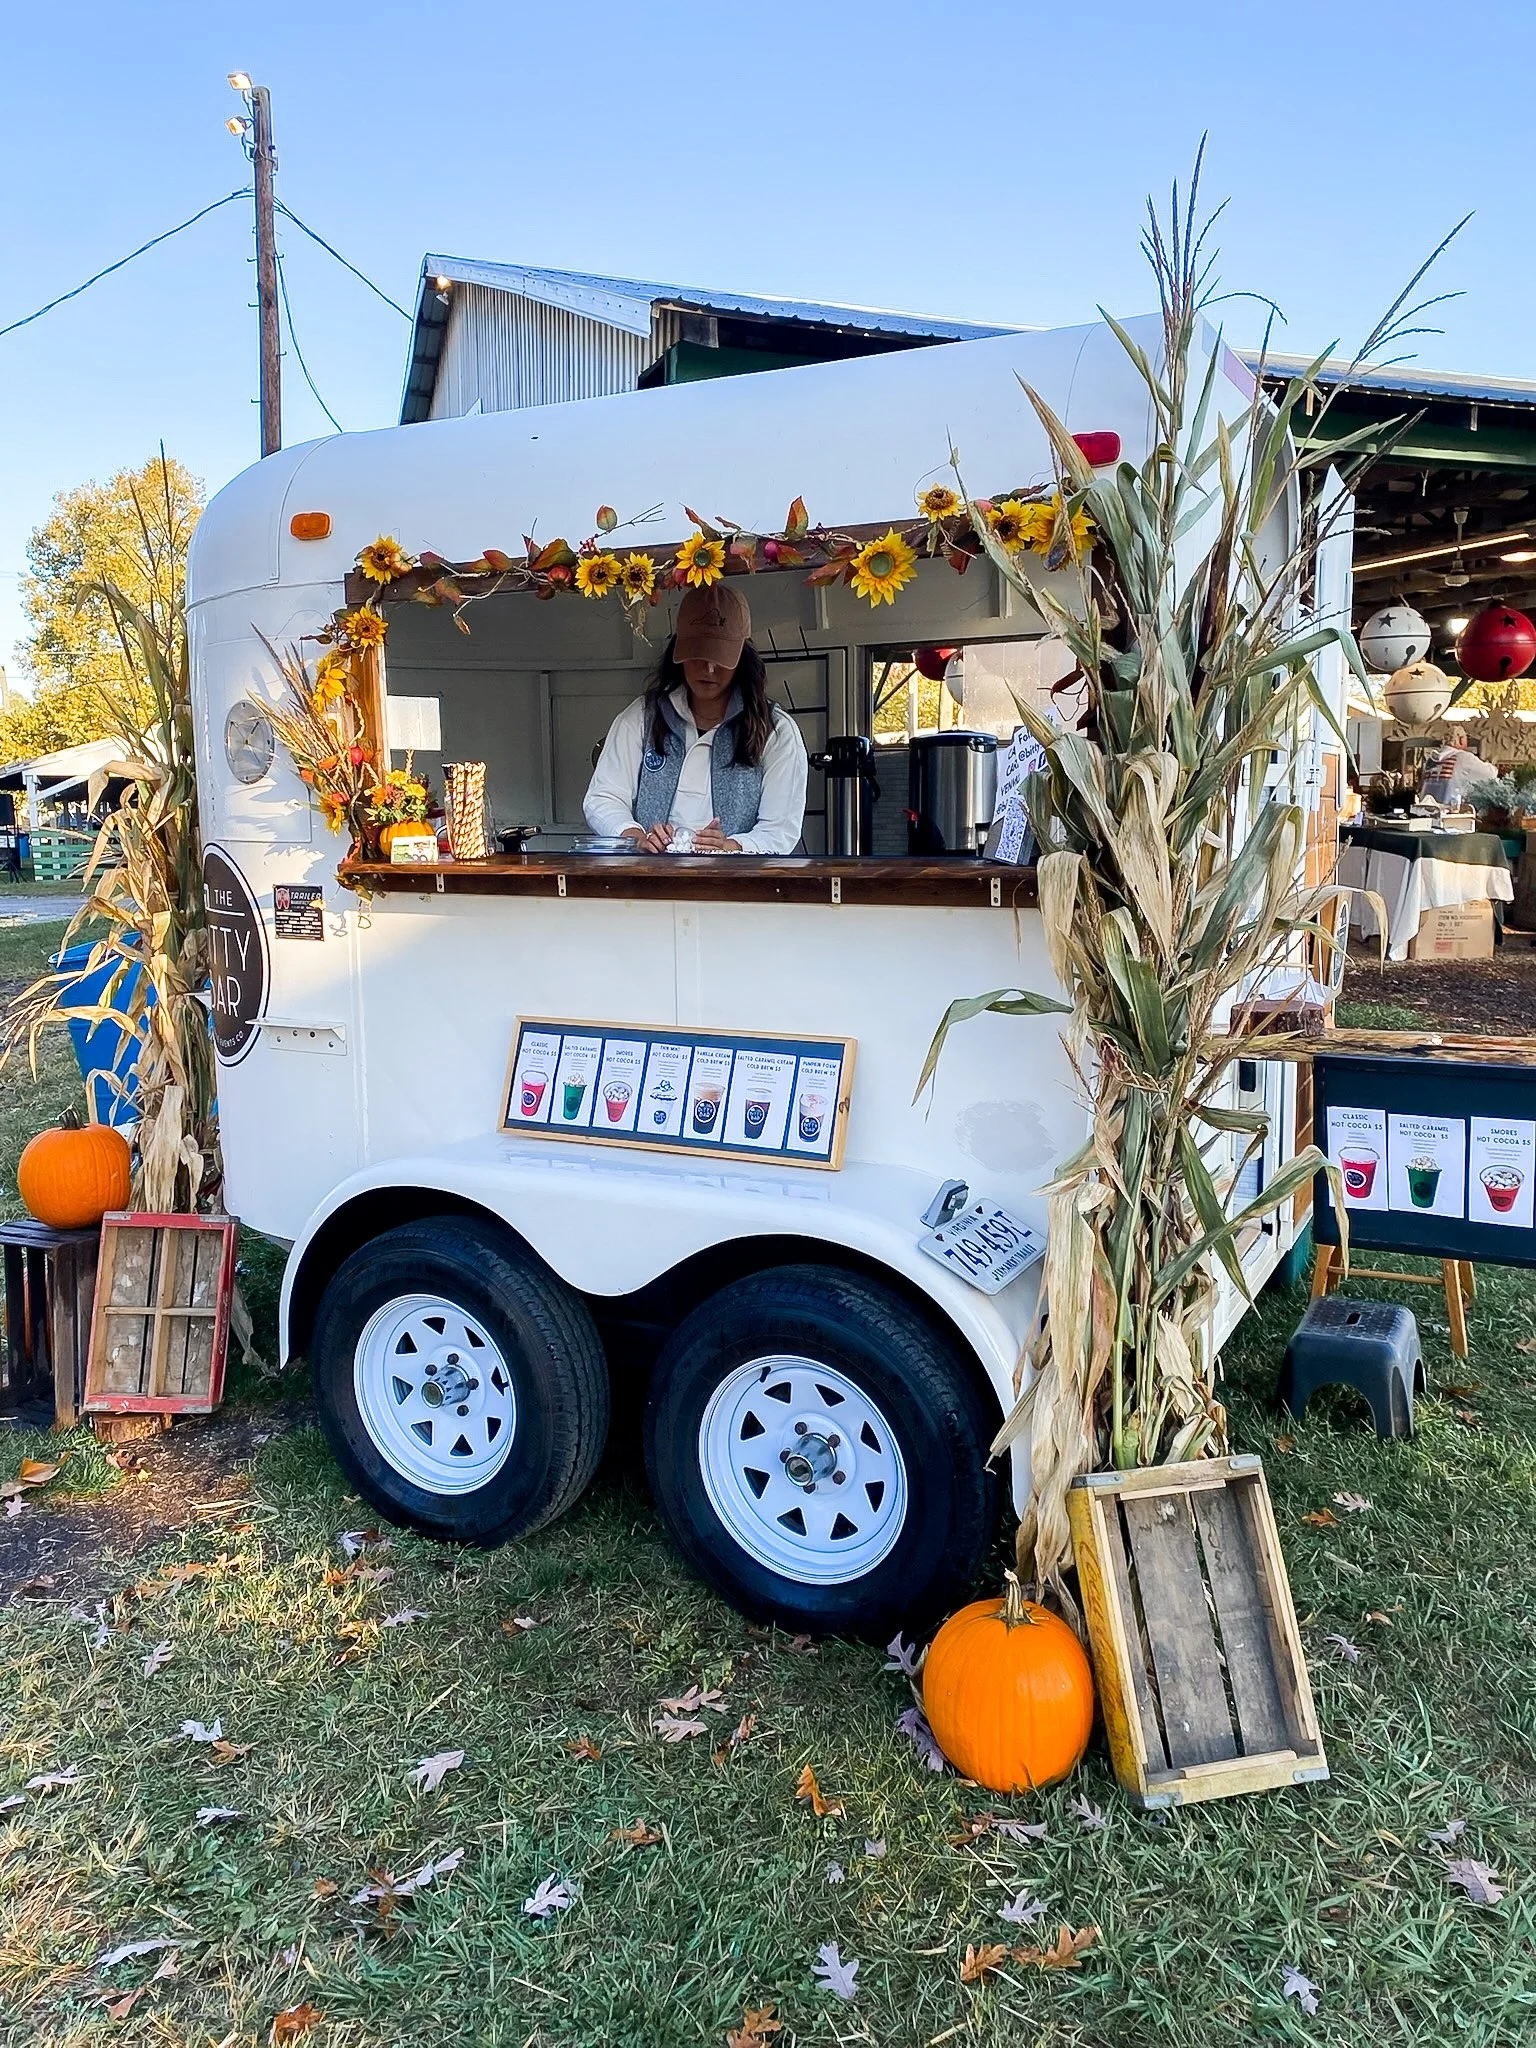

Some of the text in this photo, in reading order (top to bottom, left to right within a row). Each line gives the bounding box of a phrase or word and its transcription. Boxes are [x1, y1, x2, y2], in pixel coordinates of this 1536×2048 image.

[214, 889, 233, 907] THE
[207, 924, 251, 972] ITTY
[1342, 1113, 1369, 1121] CLASSIC
[1422, 1124, 1449, 1132] CARAMEL
[1490, 1128, 1518, 1136] SMORES
[1493, 1137, 1520, 1145] COCOA
[946, 1214, 979, 1237] VIRGINIA
